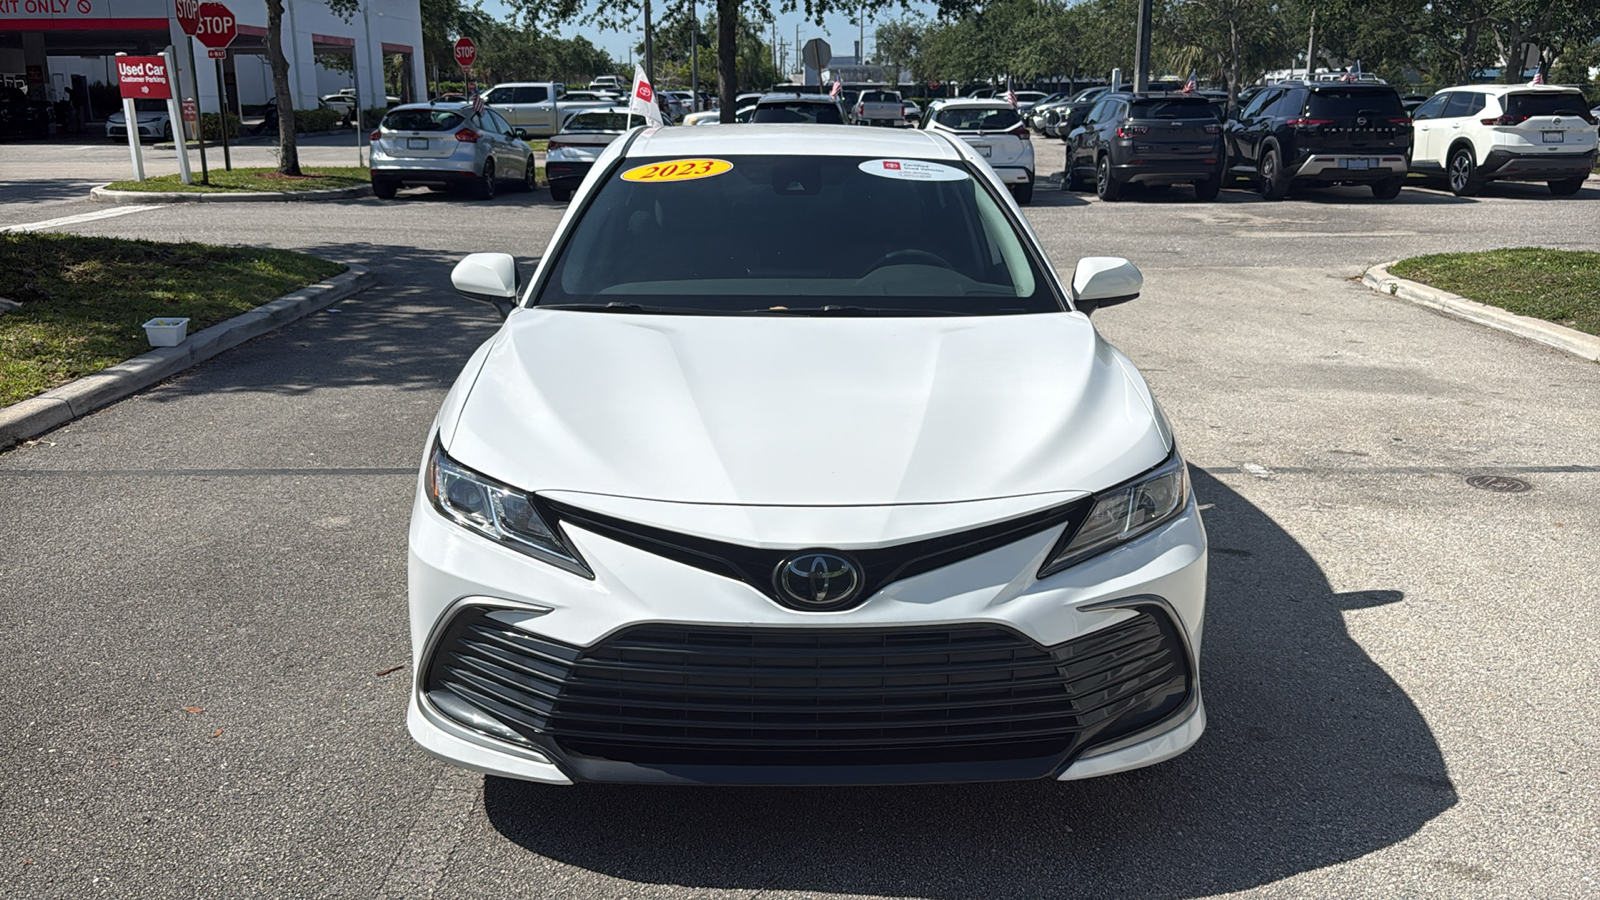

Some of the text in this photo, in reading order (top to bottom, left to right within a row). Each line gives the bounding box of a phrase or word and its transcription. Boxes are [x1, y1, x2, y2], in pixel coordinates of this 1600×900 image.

[25, 0, 70, 13] ONLY
[176, 0, 198, 19] STOP
[197, 16, 233, 34] STOP
[456, 46, 474, 58] STOP
[118, 62, 164, 75] Used Car
[145, 76, 166, 85] Parking
[640, 161, 714, 179] 2023
